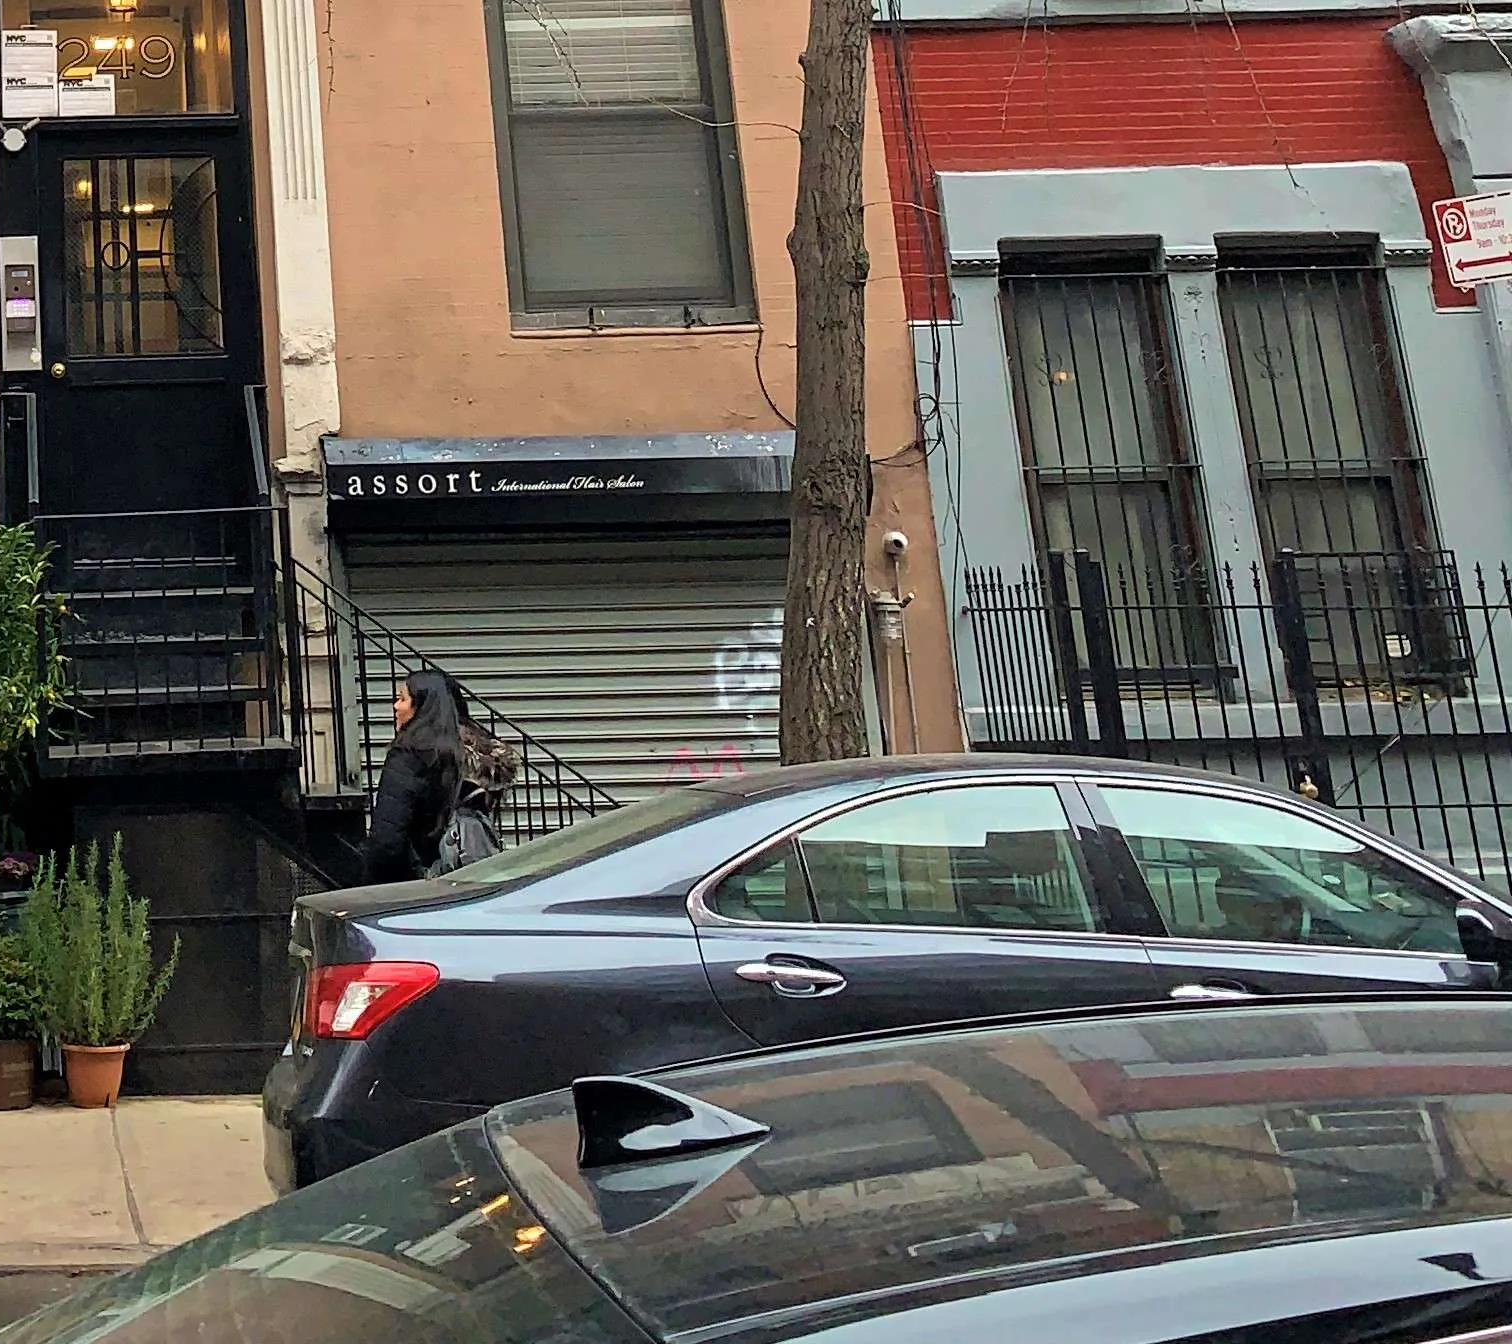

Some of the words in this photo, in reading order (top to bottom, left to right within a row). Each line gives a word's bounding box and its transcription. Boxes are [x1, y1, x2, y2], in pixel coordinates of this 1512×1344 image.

[56, 34, 176, 81] 249
[347, 470, 482, 496] assort
[491, 477, 575, 492] International
[573, 475, 604, 490] Hair
[607, 474, 644, 490] Salon
